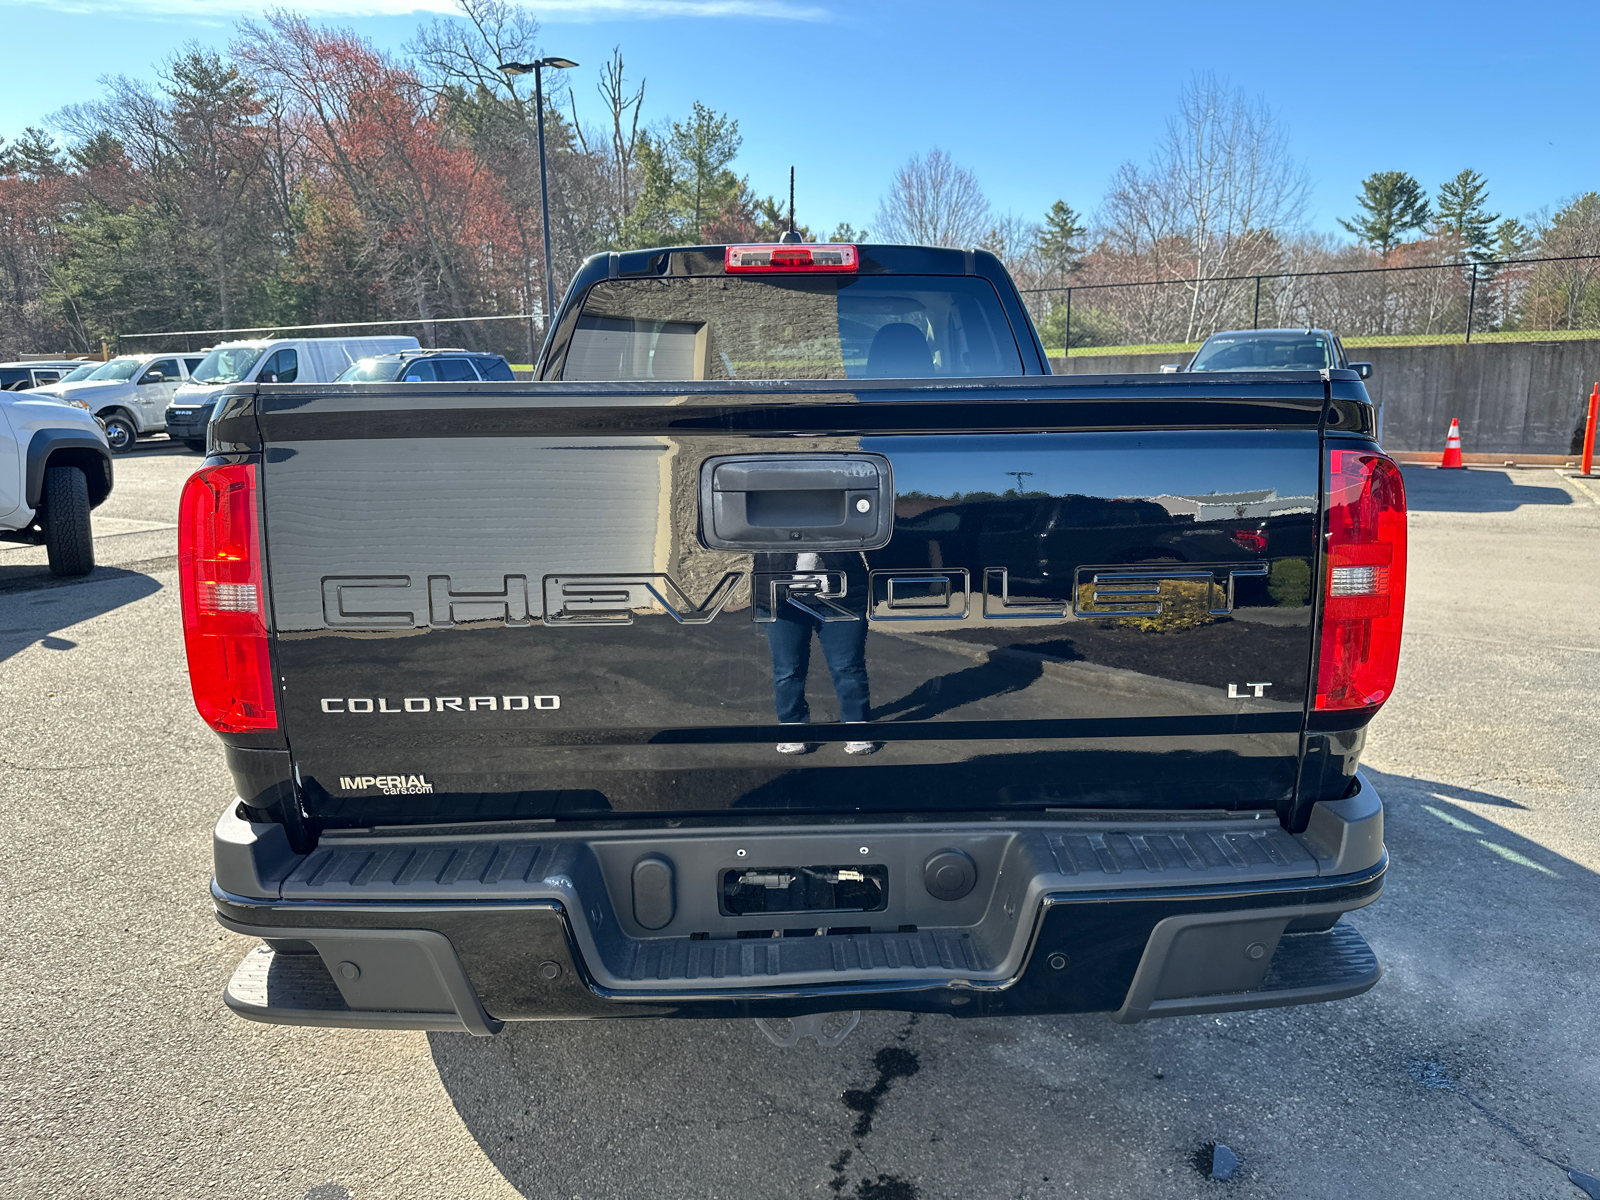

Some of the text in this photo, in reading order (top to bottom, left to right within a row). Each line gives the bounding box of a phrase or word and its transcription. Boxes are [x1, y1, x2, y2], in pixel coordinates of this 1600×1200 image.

[320, 562, 1269, 627] CHEVROLET
[1228, 682, 1273, 699] LT
[320, 695, 561, 713] COLORADO
[339, 774, 433, 790] IMPERIAL
[382, 786, 434, 796] cars.com
